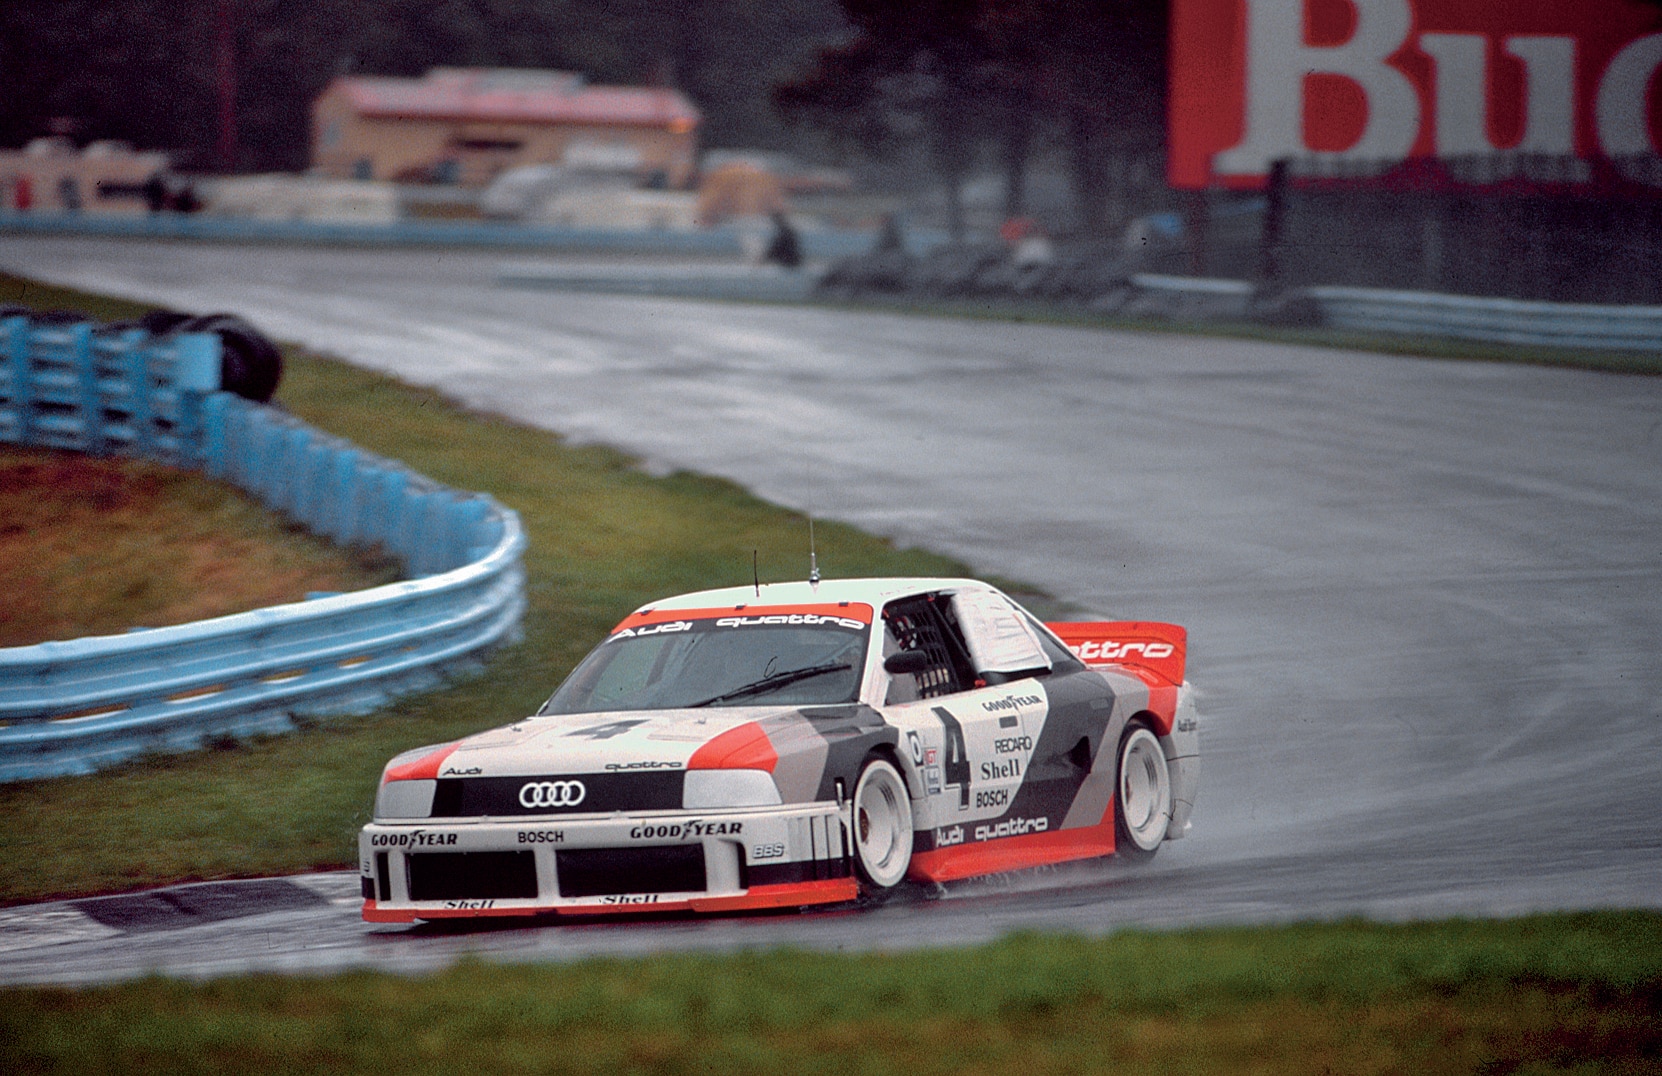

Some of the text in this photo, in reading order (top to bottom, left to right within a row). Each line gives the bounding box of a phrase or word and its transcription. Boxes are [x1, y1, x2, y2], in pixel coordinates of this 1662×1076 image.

[608, 613, 866, 642] Audi quattro
[1065, 641, 1174, 659] ttro
[561, 719, 650, 740] 4
[994, 735, 1033, 754] RECARO
[605, 761, 683, 771] quattro
[931, 706, 971, 810] 4
[442, 766, 483, 777] Audi
[981, 758, 1021, 781] Shell
[976, 789, 1009, 809] BOSCH
[518, 830, 565, 844] BOSCH
[936, 816, 1049, 848] Audi quattro
[753, 844, 785, 859] BBS
[445, 900, 495, 909] Shell
[602, 894, 659, 904] Shell
